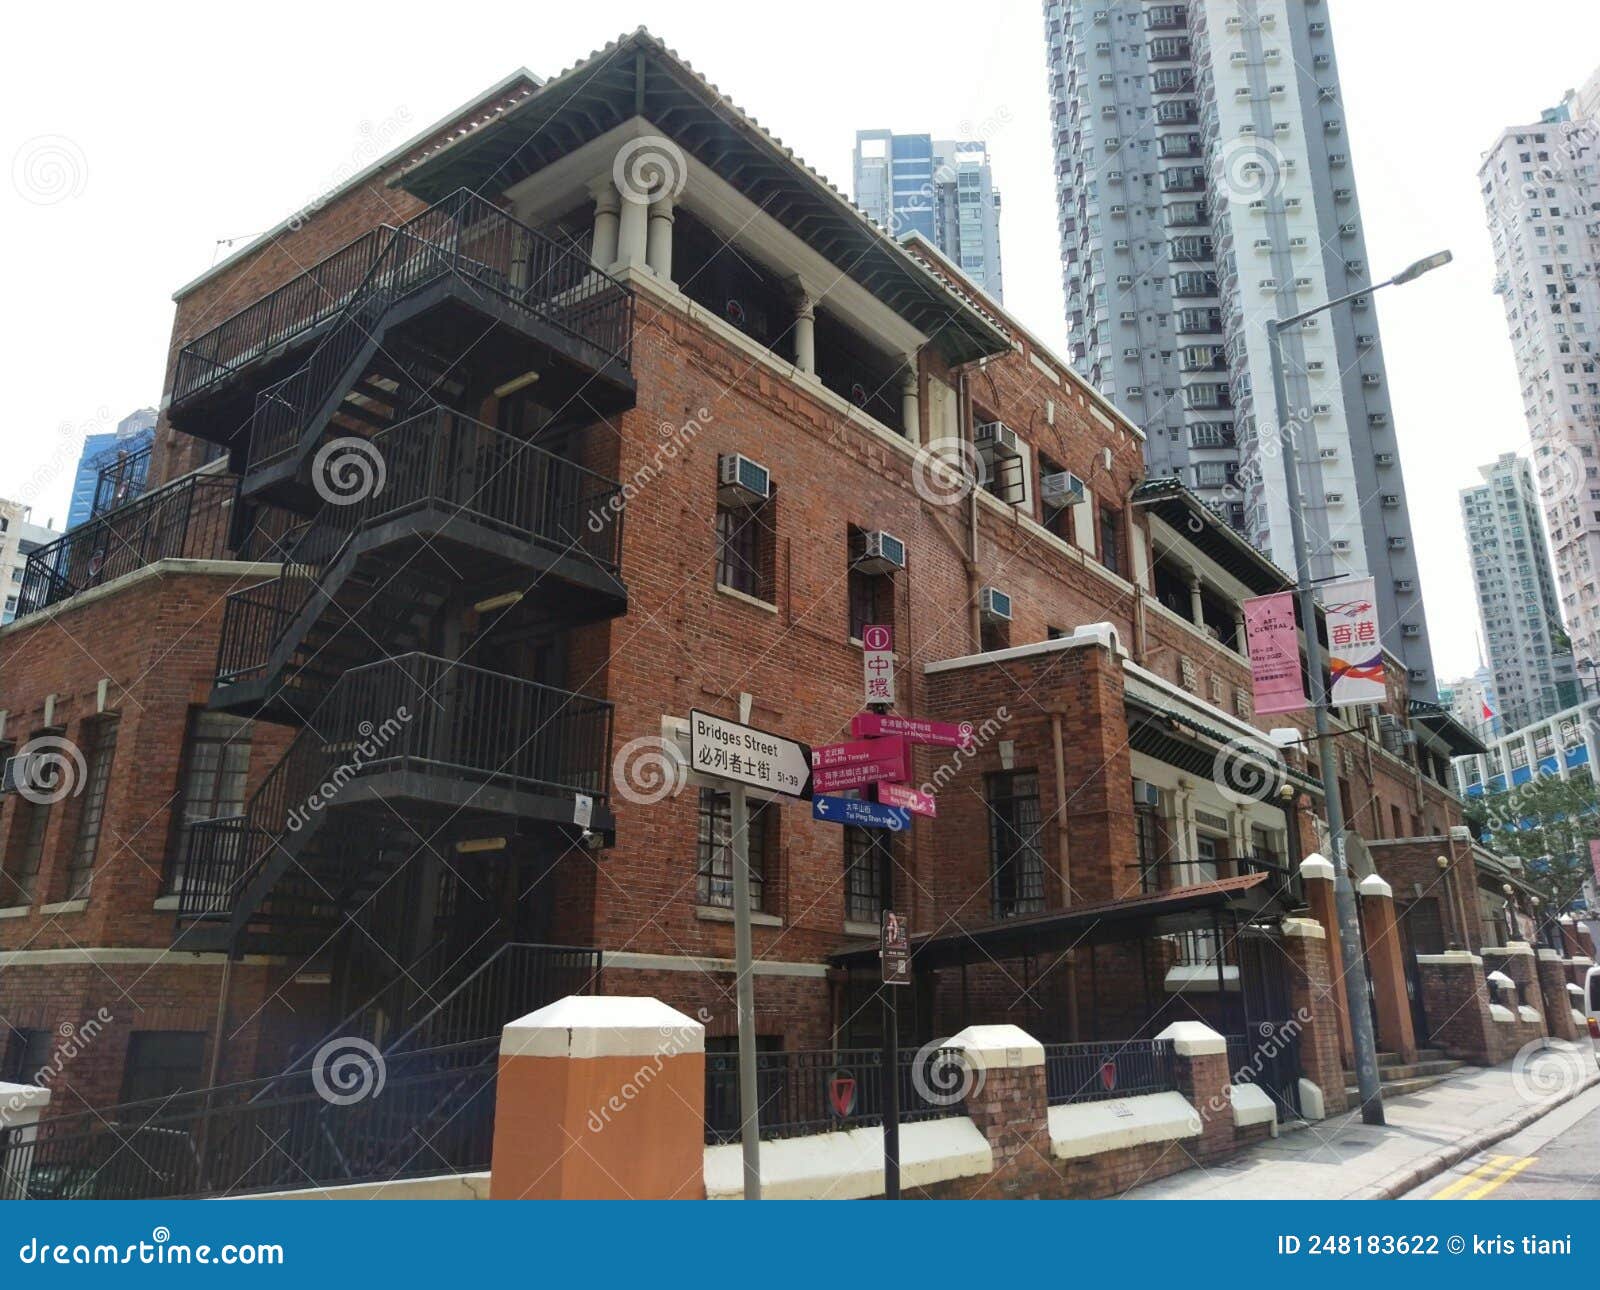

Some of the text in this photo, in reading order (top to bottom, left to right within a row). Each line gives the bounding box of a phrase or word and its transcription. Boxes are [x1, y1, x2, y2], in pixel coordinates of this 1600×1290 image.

[1254, 623, 1288, 633] CENTRAL
[1332, 620, 1375, 645] 香港
[868, 655, 891, 698] 中環
[697, 720, 778, 758] Bridges Street
[698, 744, 771, 782] 必列者士街
[848, 751, 870, 761] Temple
[824, 775, 857, 788] Hollywood
[857, 774, 866, 782] Rd
[845, 811, 855, 820] Tai
[855, 813, 868, 823] Ping
[868, 814, 882, 823] Shan
